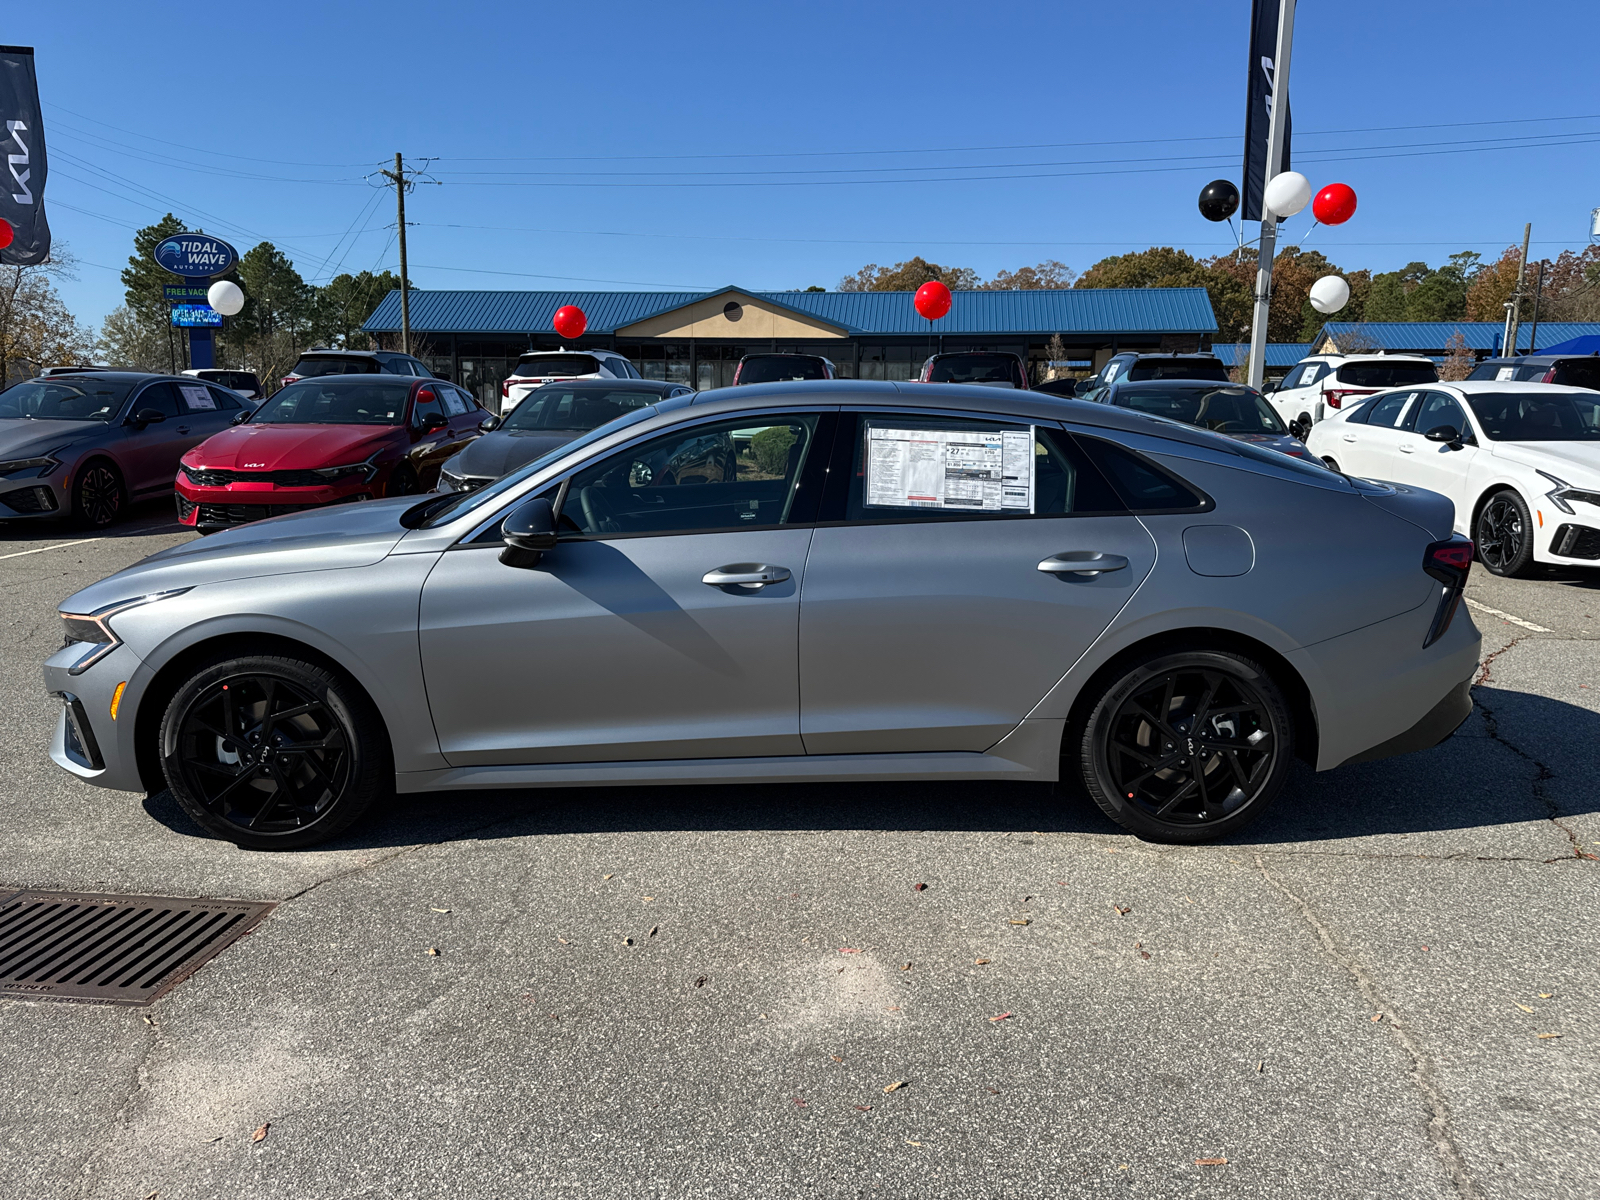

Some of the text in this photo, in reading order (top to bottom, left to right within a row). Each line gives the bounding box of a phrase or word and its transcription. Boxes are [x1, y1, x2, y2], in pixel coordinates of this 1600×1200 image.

[6, 119, 33, 205] KIA
[181, 241, 218, 253] TIDAL
[188, 253, 226, 264] WAVE
[166, 288, 208, 296] FREE VACU
[950, 447, 960, 455] 27
[260, 745, 269, 763] KIA
